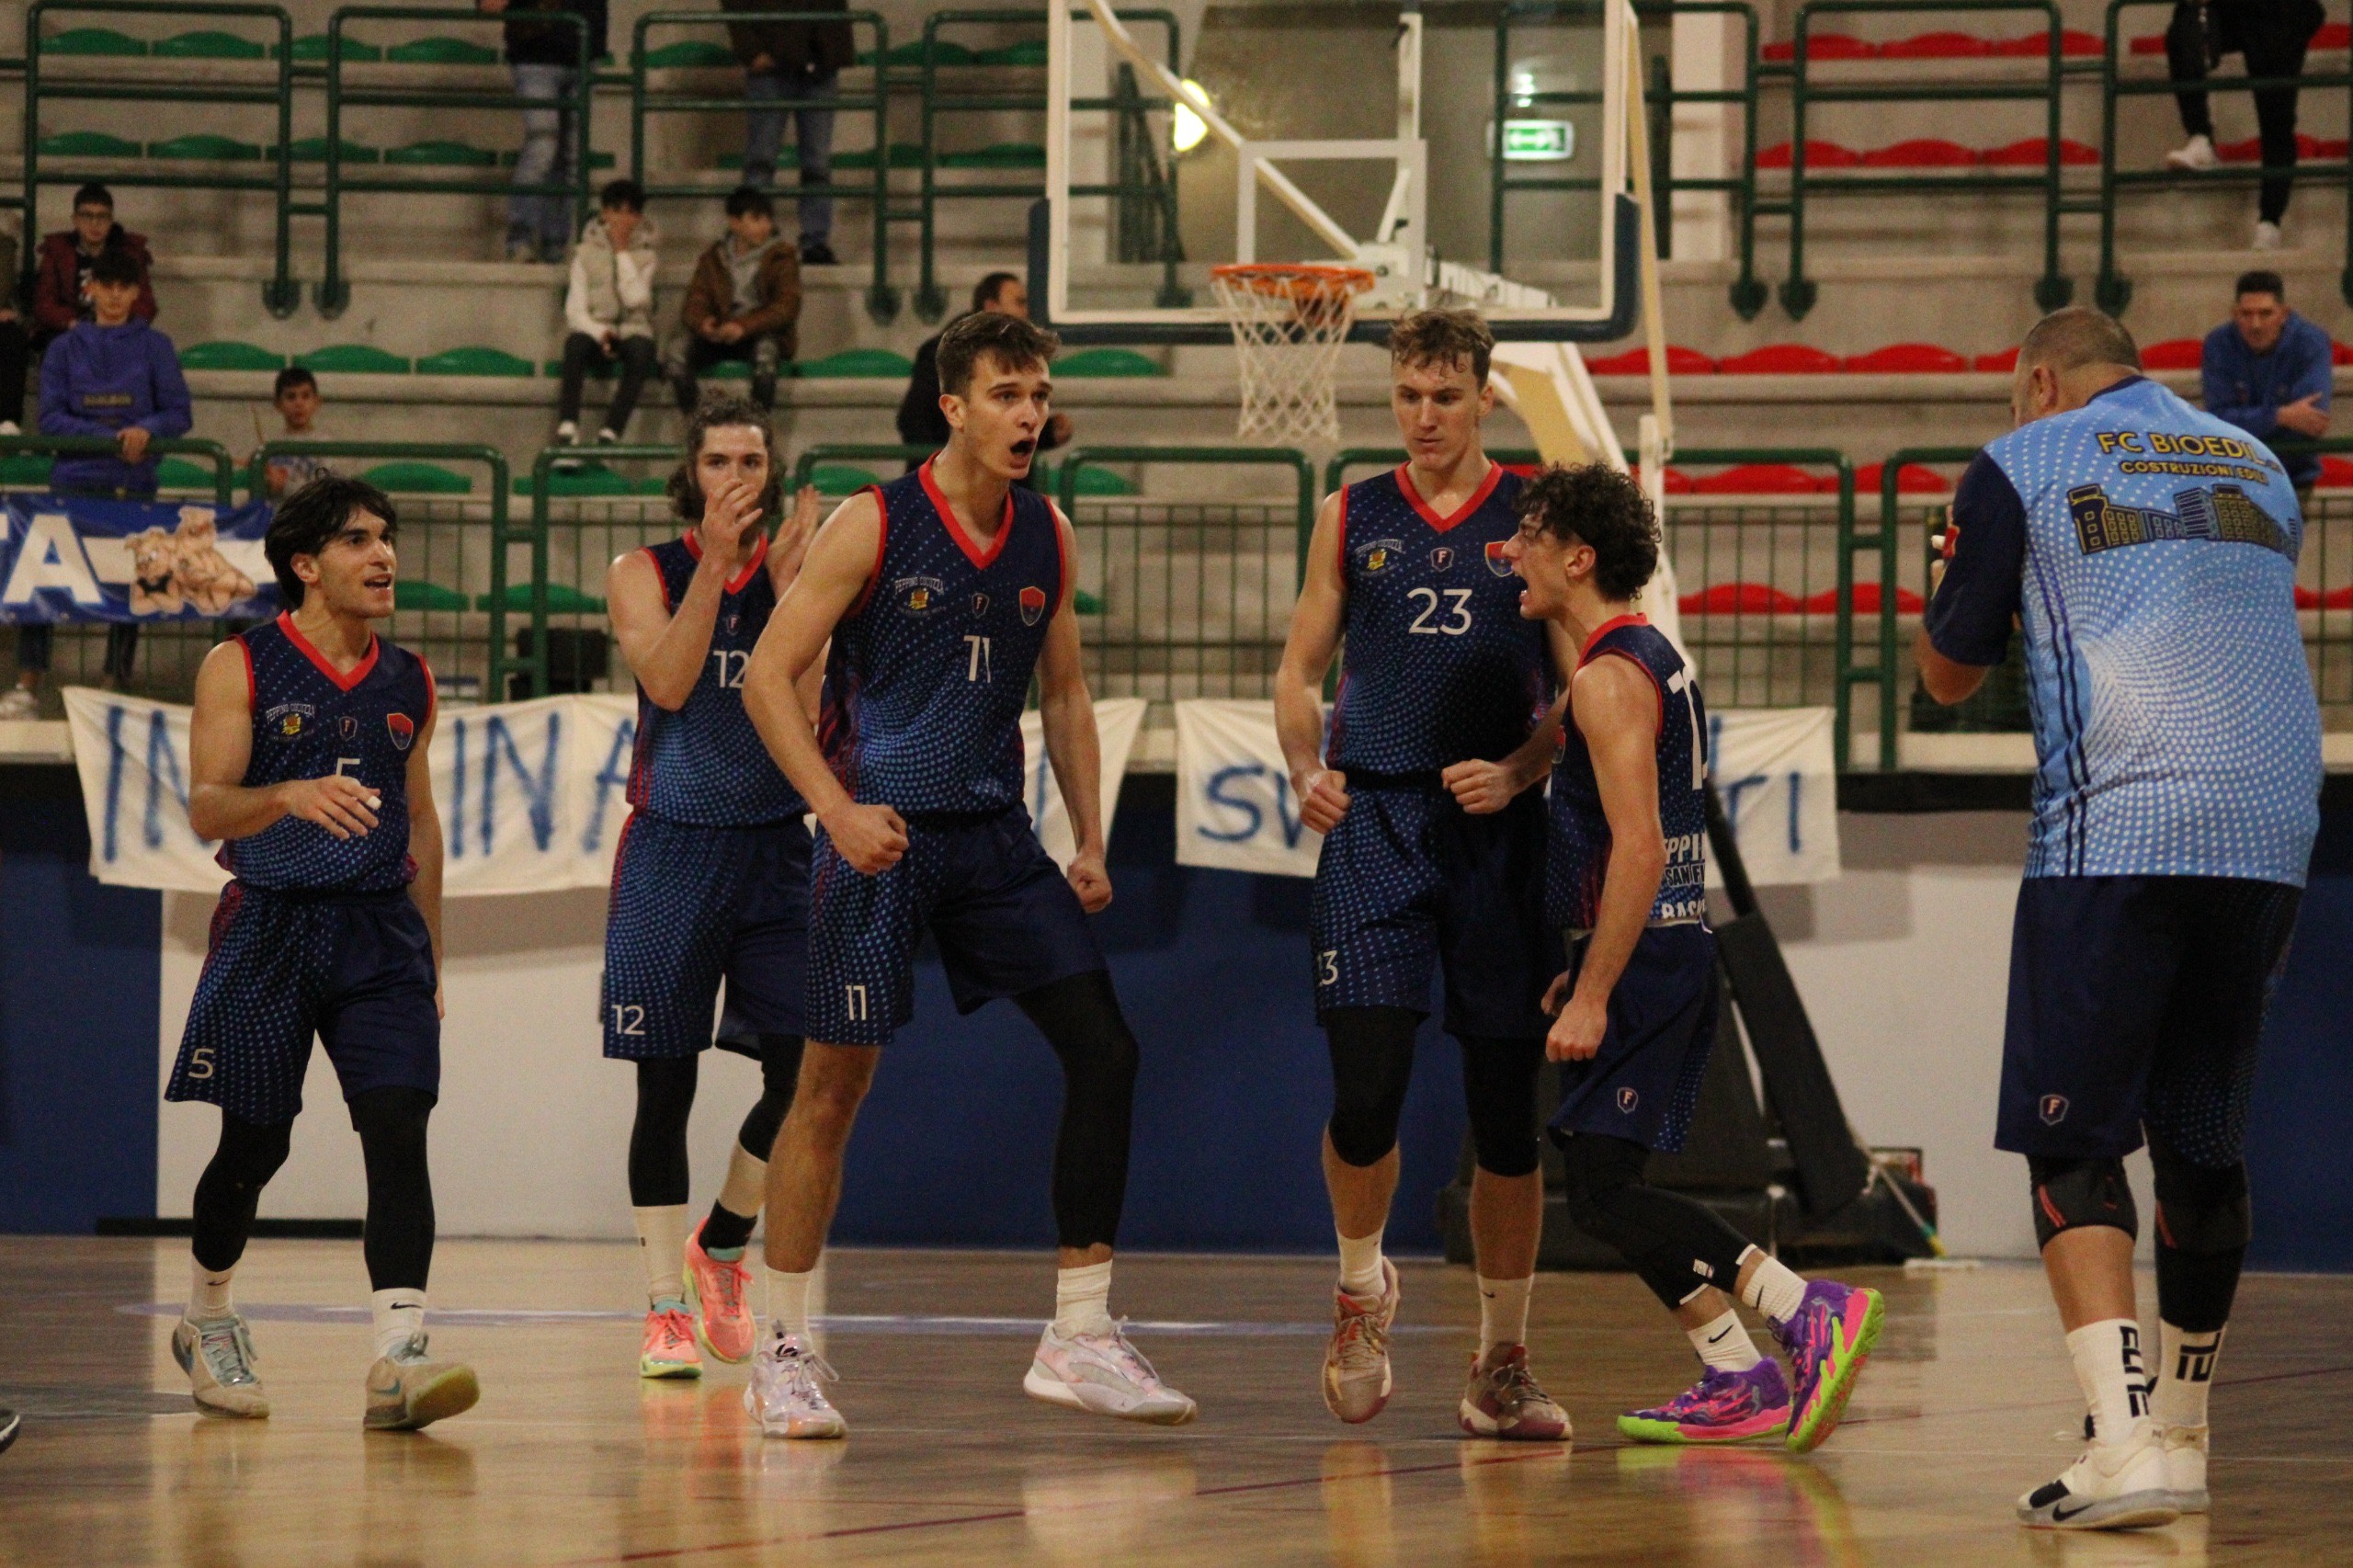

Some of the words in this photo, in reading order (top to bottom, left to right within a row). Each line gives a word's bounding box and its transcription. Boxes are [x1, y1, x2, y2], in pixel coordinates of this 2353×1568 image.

[2096, 431, 2144, 454] FC
[2120, 460, 2234, 476] COSTRUZIONI
[0, 512, 104, 605] A
[1407, 587, 1472, 635] 23
[846, 984, 867, 1021] 11
[611, 1004, 646, 1036] 12
[188, 1048, 214, 1079] 5
